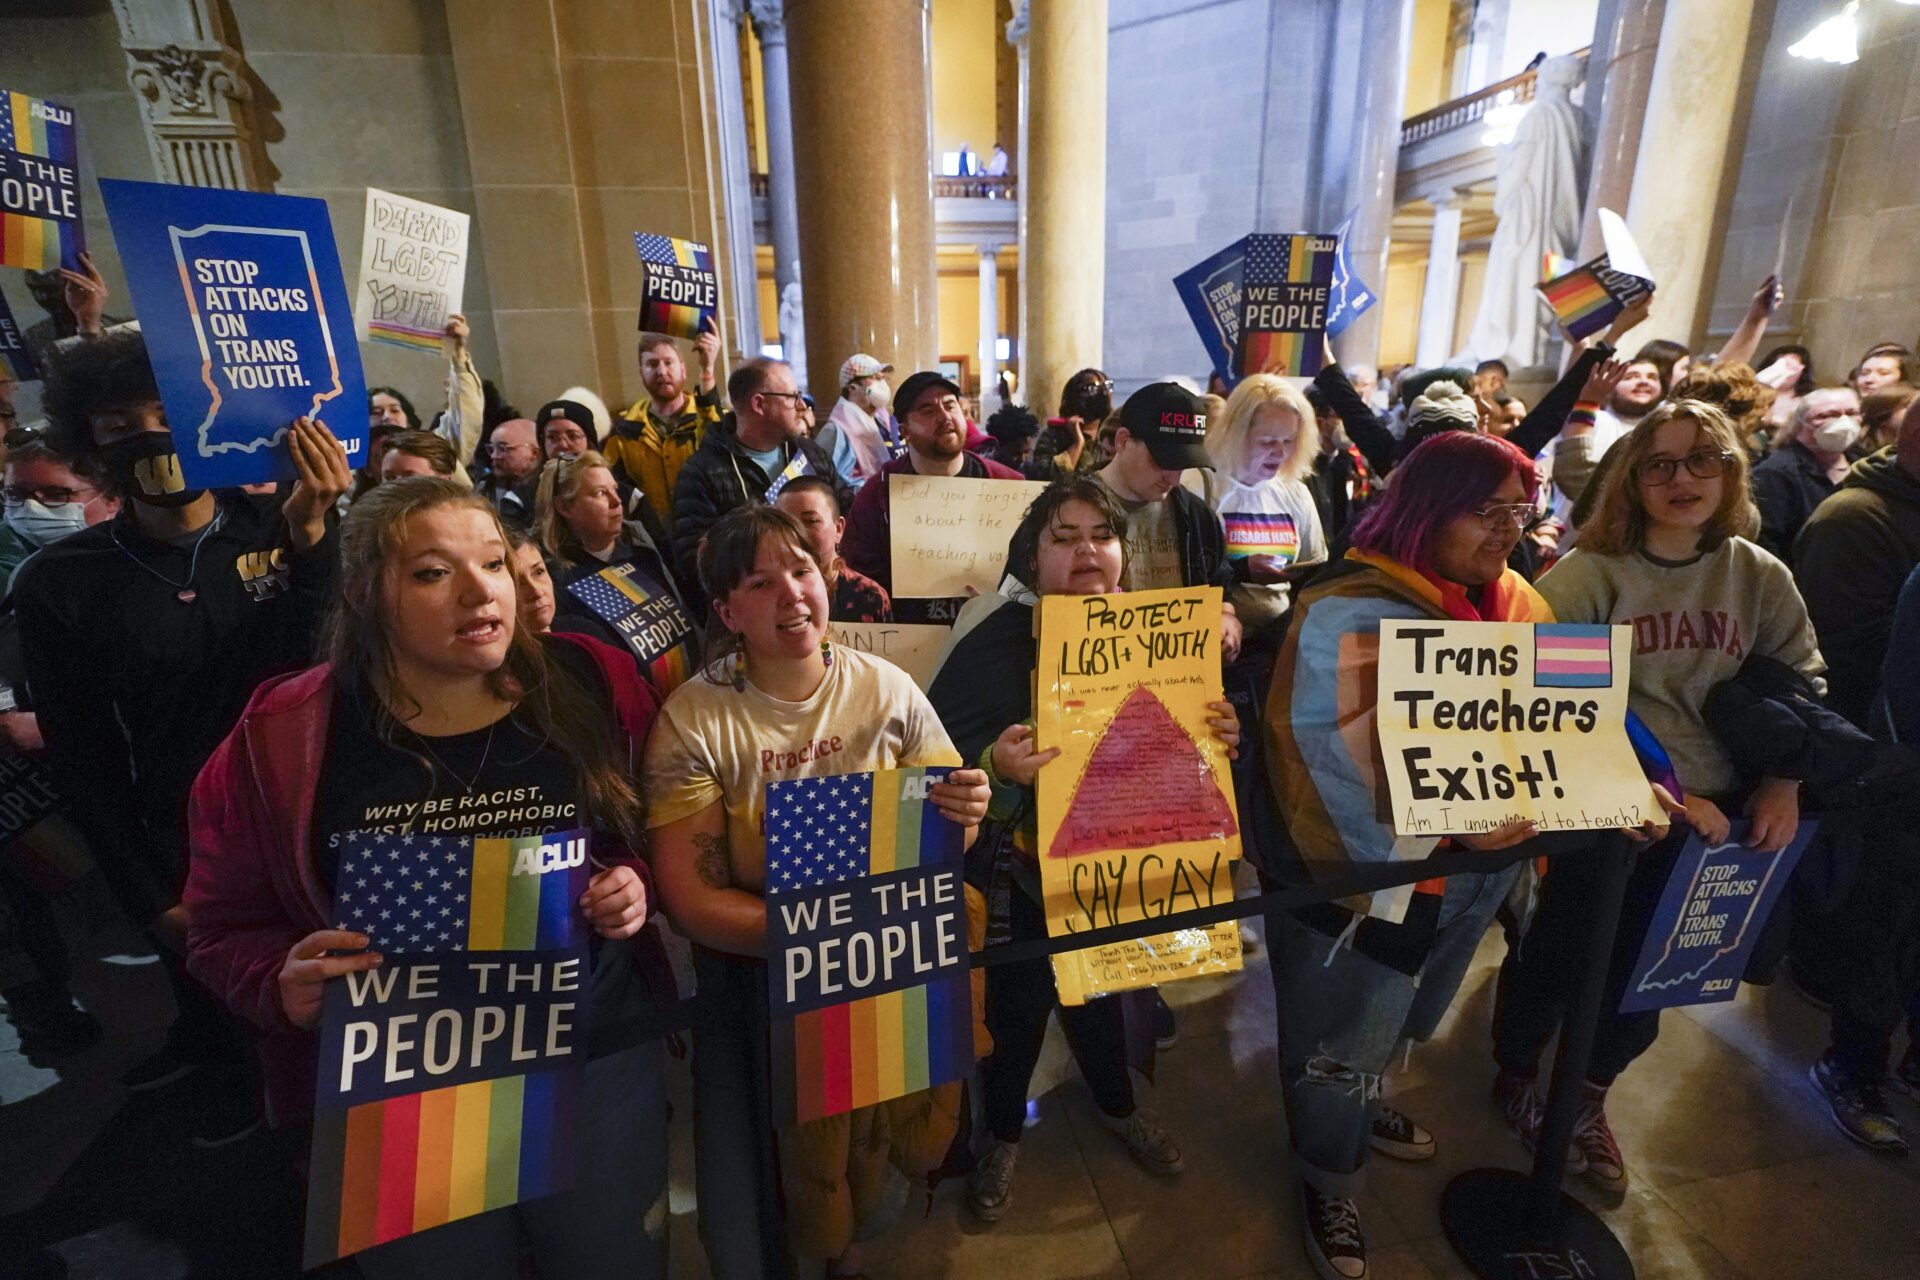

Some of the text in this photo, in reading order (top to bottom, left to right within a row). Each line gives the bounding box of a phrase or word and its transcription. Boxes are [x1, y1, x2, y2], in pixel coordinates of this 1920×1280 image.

[31, 101, 72, 126] ACLU
[18, 158, 74, 186] THE
[2, 178, 77, 218] OPLE
[373, 197, 461, 247] DEFEND
[1304, 239, 1335, 252] ACLU
[195, 258, 259, 285] STOP
[371, 237, 459, 287] LGBT
[646, 262, 714, 285] WE THE
[205, 286, 309, 312] ATTACKS
[367, 279, 448, 330] YOUTH
[648, 276, 714, 306] PEOPLE
[1247, 287, 1327, 301] WE THE
[210, 313, 248, 338] ON
[1245, 305, 1324, 329] PEOPLE
[215, 339, 298, 364] TRANS
[222, 364, 311, 389] YOUTH.
[900, 481, 930, 501] Did
[941, 491, 966, 508] you
[914, 513, 966, 527] about
[977, 514, 1003, 528] the
[1229, 530, 1270, 544] DISARM
[909, 544, 978, 571] teaching
[616, 595, 675, 634] WE THE
[1083, 597, 1203, 632] PROTECT
[631, 609, 691, 660] PEOPLE
[1622, 610, 1743, 660] DIANA
[1061, 629, 1209, 677] LGBT+ YOUTH
[1396, 628, 1519, 676] Trans
[1394, 688, 1599, 733] Teachers
[761, 735, 844, 773] Practice
[1401, 747, 1565, 801] Exist!
[364, 786, 544, 821] WHY BE RACIST,
[424, 803, 576, 834] HOMOPHOBIC
[1405, 806, 1432, 833] Am
[1439, 807, 1453, 831] I
[1555, 815, 1575, 830] to
[1579, 804, 1642, 830] teach?
[511, 838, 586, 877] ACLU
[1701, 864, 1739, 883] STOP
[780, 872, 956, 935] WE THE
[1065, 851, 1221, 933] SAY GAY
[1694, 879, 1758, 900] ATTACKS
[1683, 913, 1729, 933] TRANS
[1688, 900, 1711, 917] ON
[1677, 930, 1722, 949] YOUTH.
[785, 913, 959, 1003] PEOPLE
[345, 958, 580, 1007] WE THE
[1700, 978, 1734, 993] ACLU
[340, 1002, 576, 1093] PEOPLE
